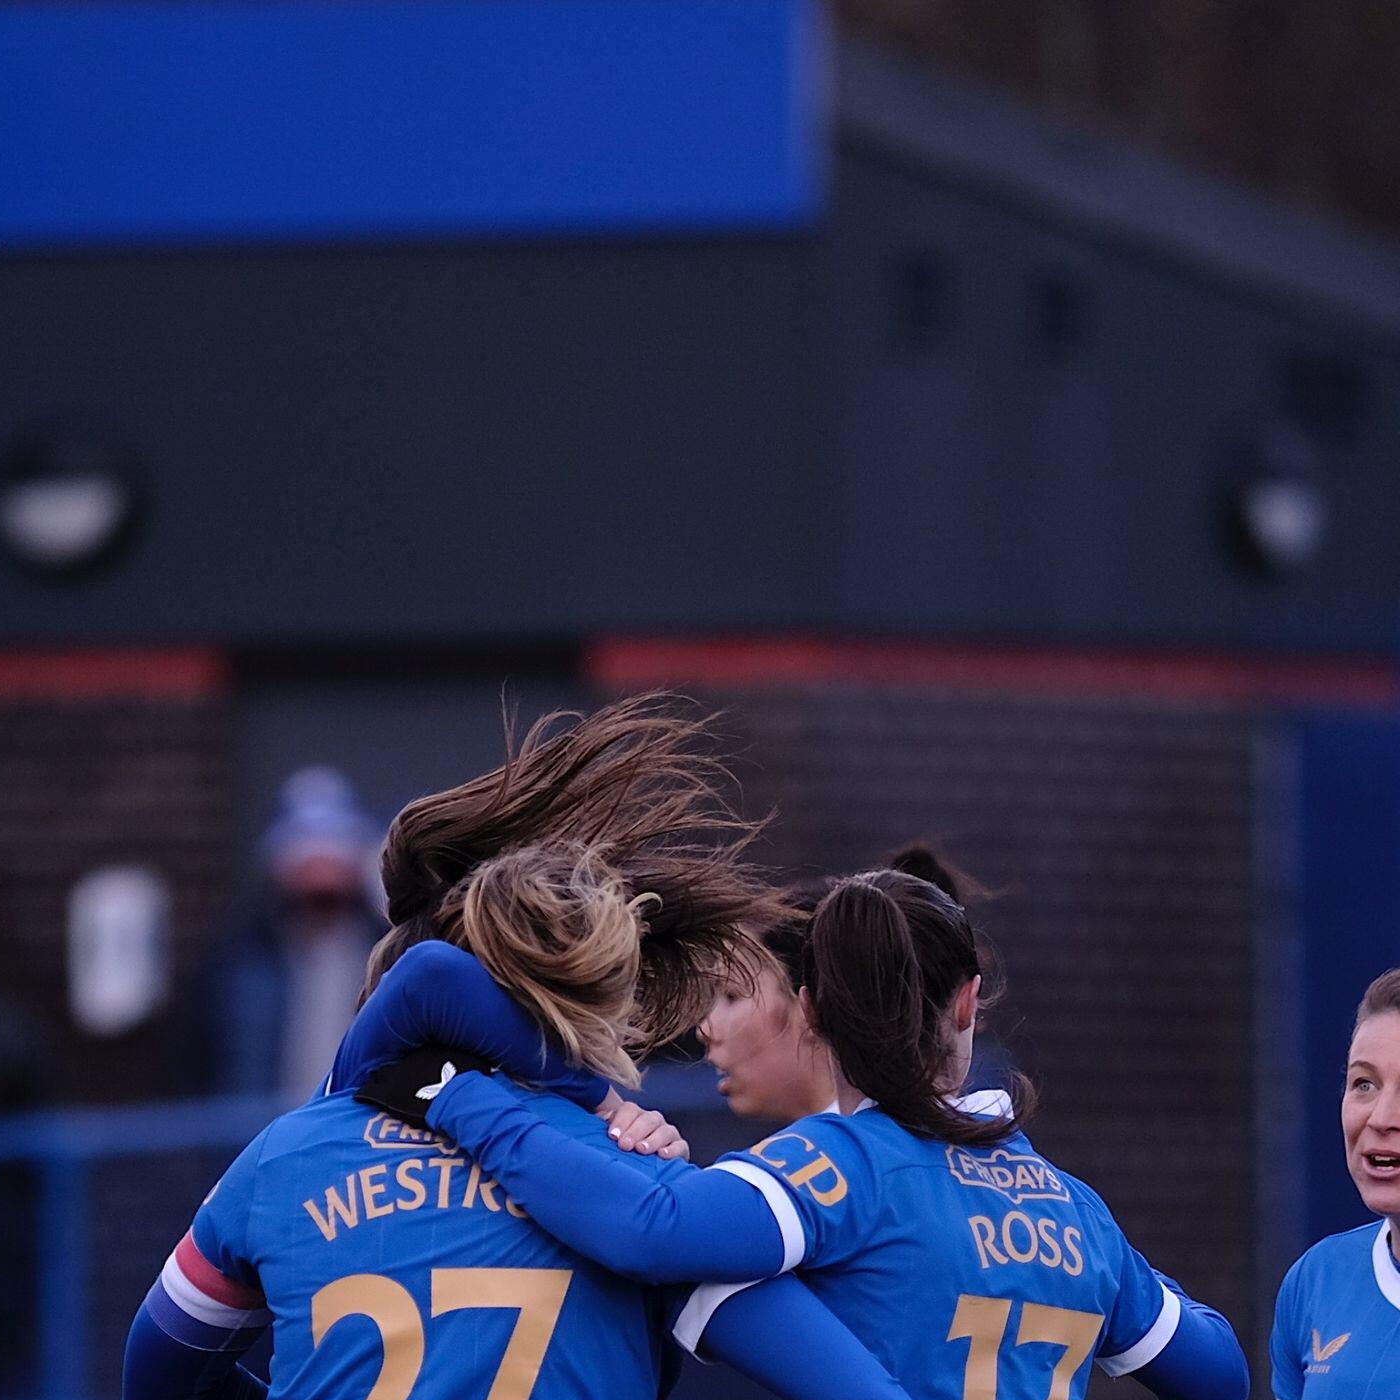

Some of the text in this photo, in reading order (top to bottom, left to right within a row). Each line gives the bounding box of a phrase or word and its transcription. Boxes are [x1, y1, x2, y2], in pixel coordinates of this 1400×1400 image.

[303, 1158, 529, 1241] WESTR
[750, 1133, 849, 1207] CP
[967, 1210, 1084, 1277] ROSS
